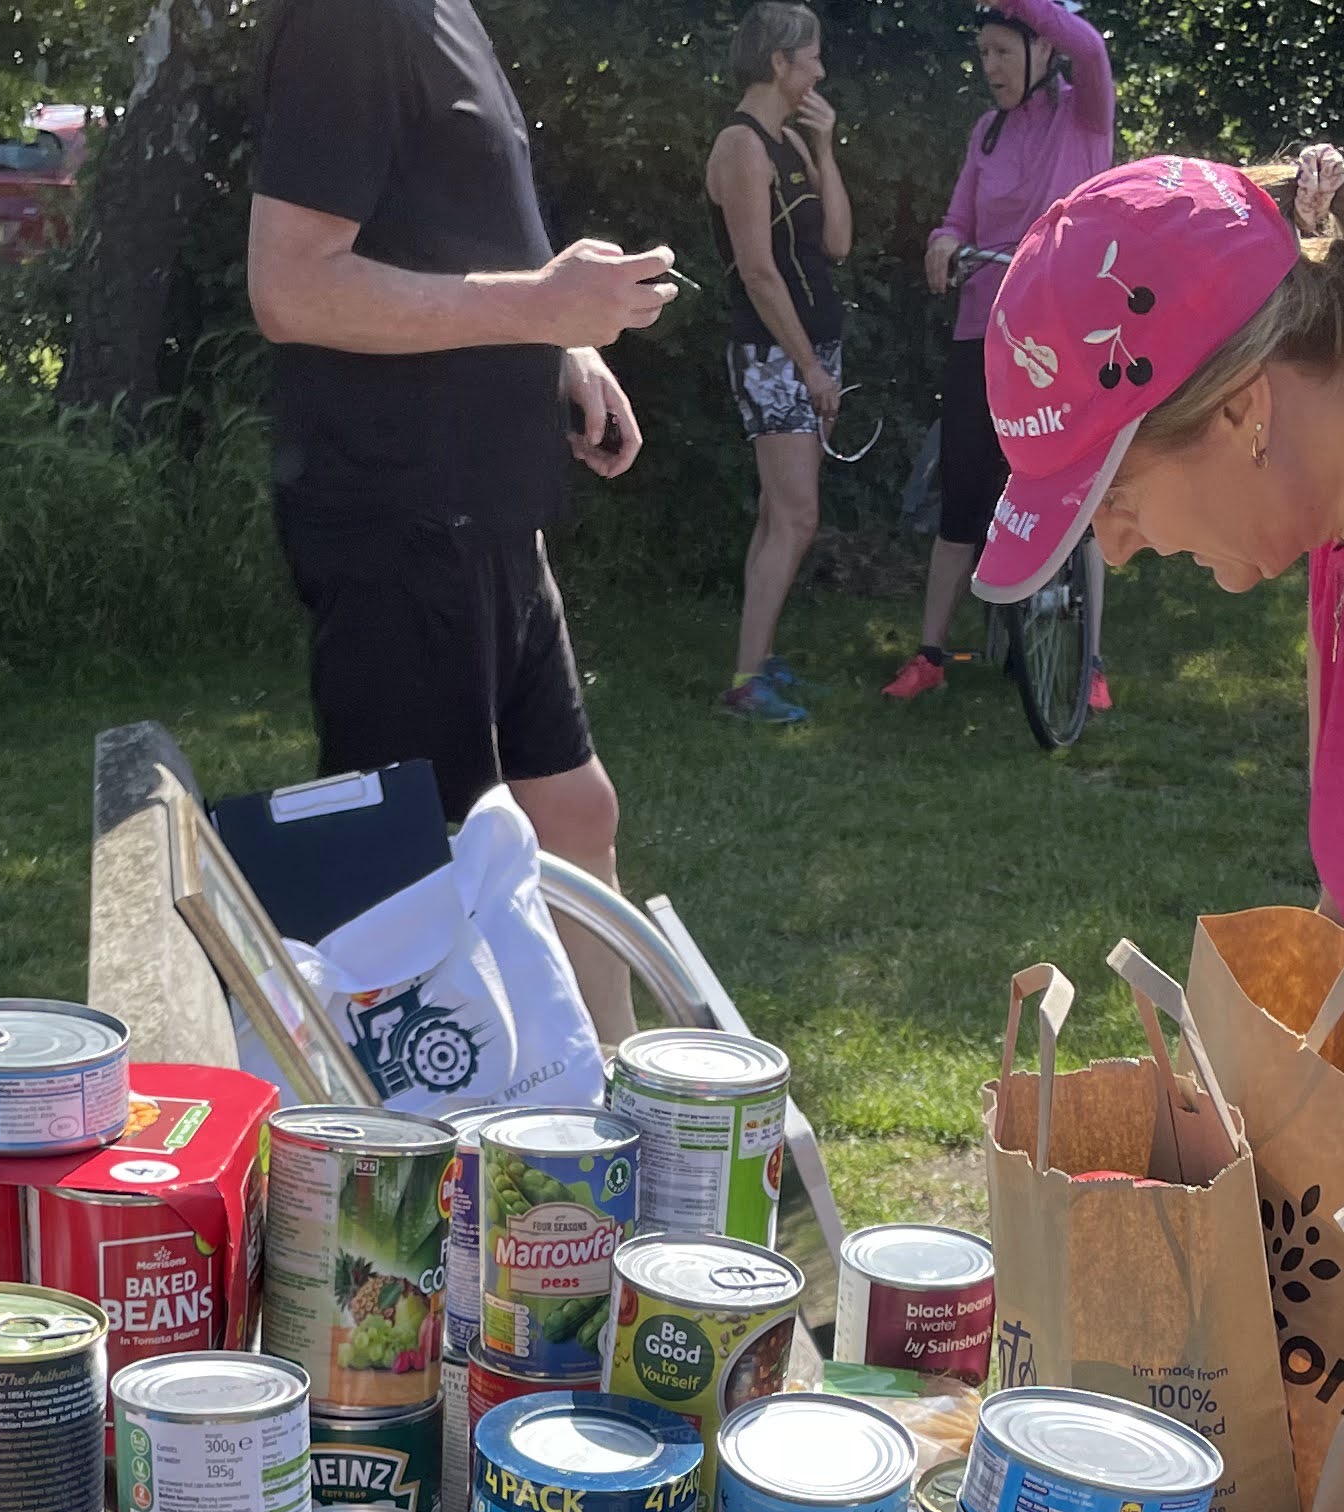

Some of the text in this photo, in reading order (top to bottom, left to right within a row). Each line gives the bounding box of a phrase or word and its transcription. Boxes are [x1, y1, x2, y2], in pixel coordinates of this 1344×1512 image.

[504, 1059, 567, 1102] WORLD
[532, 1219, 588, 1233] FOUR SEASONS
[495, 1227, 626, 1270] Marrowfat
[137, 1258, 187, 1271] Morrisons
[126, 1271, 197, 1298] BAKED
[541, 1276, 580, 1290] peas
[907, 1303, 953, 1317] black
[660, 1323, 688, 1343] Be
[921, 1320, 956, 1332] water
[131, 1328, 200, 1345] Tomato Sauce
[646, 1338, 700, 1365] Good
[905, 1337, 925, 1358] by
[28, 1364, 82, 1385] Authentic
[662, 1360, 678, 1374] to
[1133, 1364, 1228, 1382] I'm made from
[642, 1365, 701, 1391] Yourself
[1148, 1384, 1218, 1414] 100%
[205, 1440, 235, 1453] 300g
[207, 1465, 234, 1479] 195g
